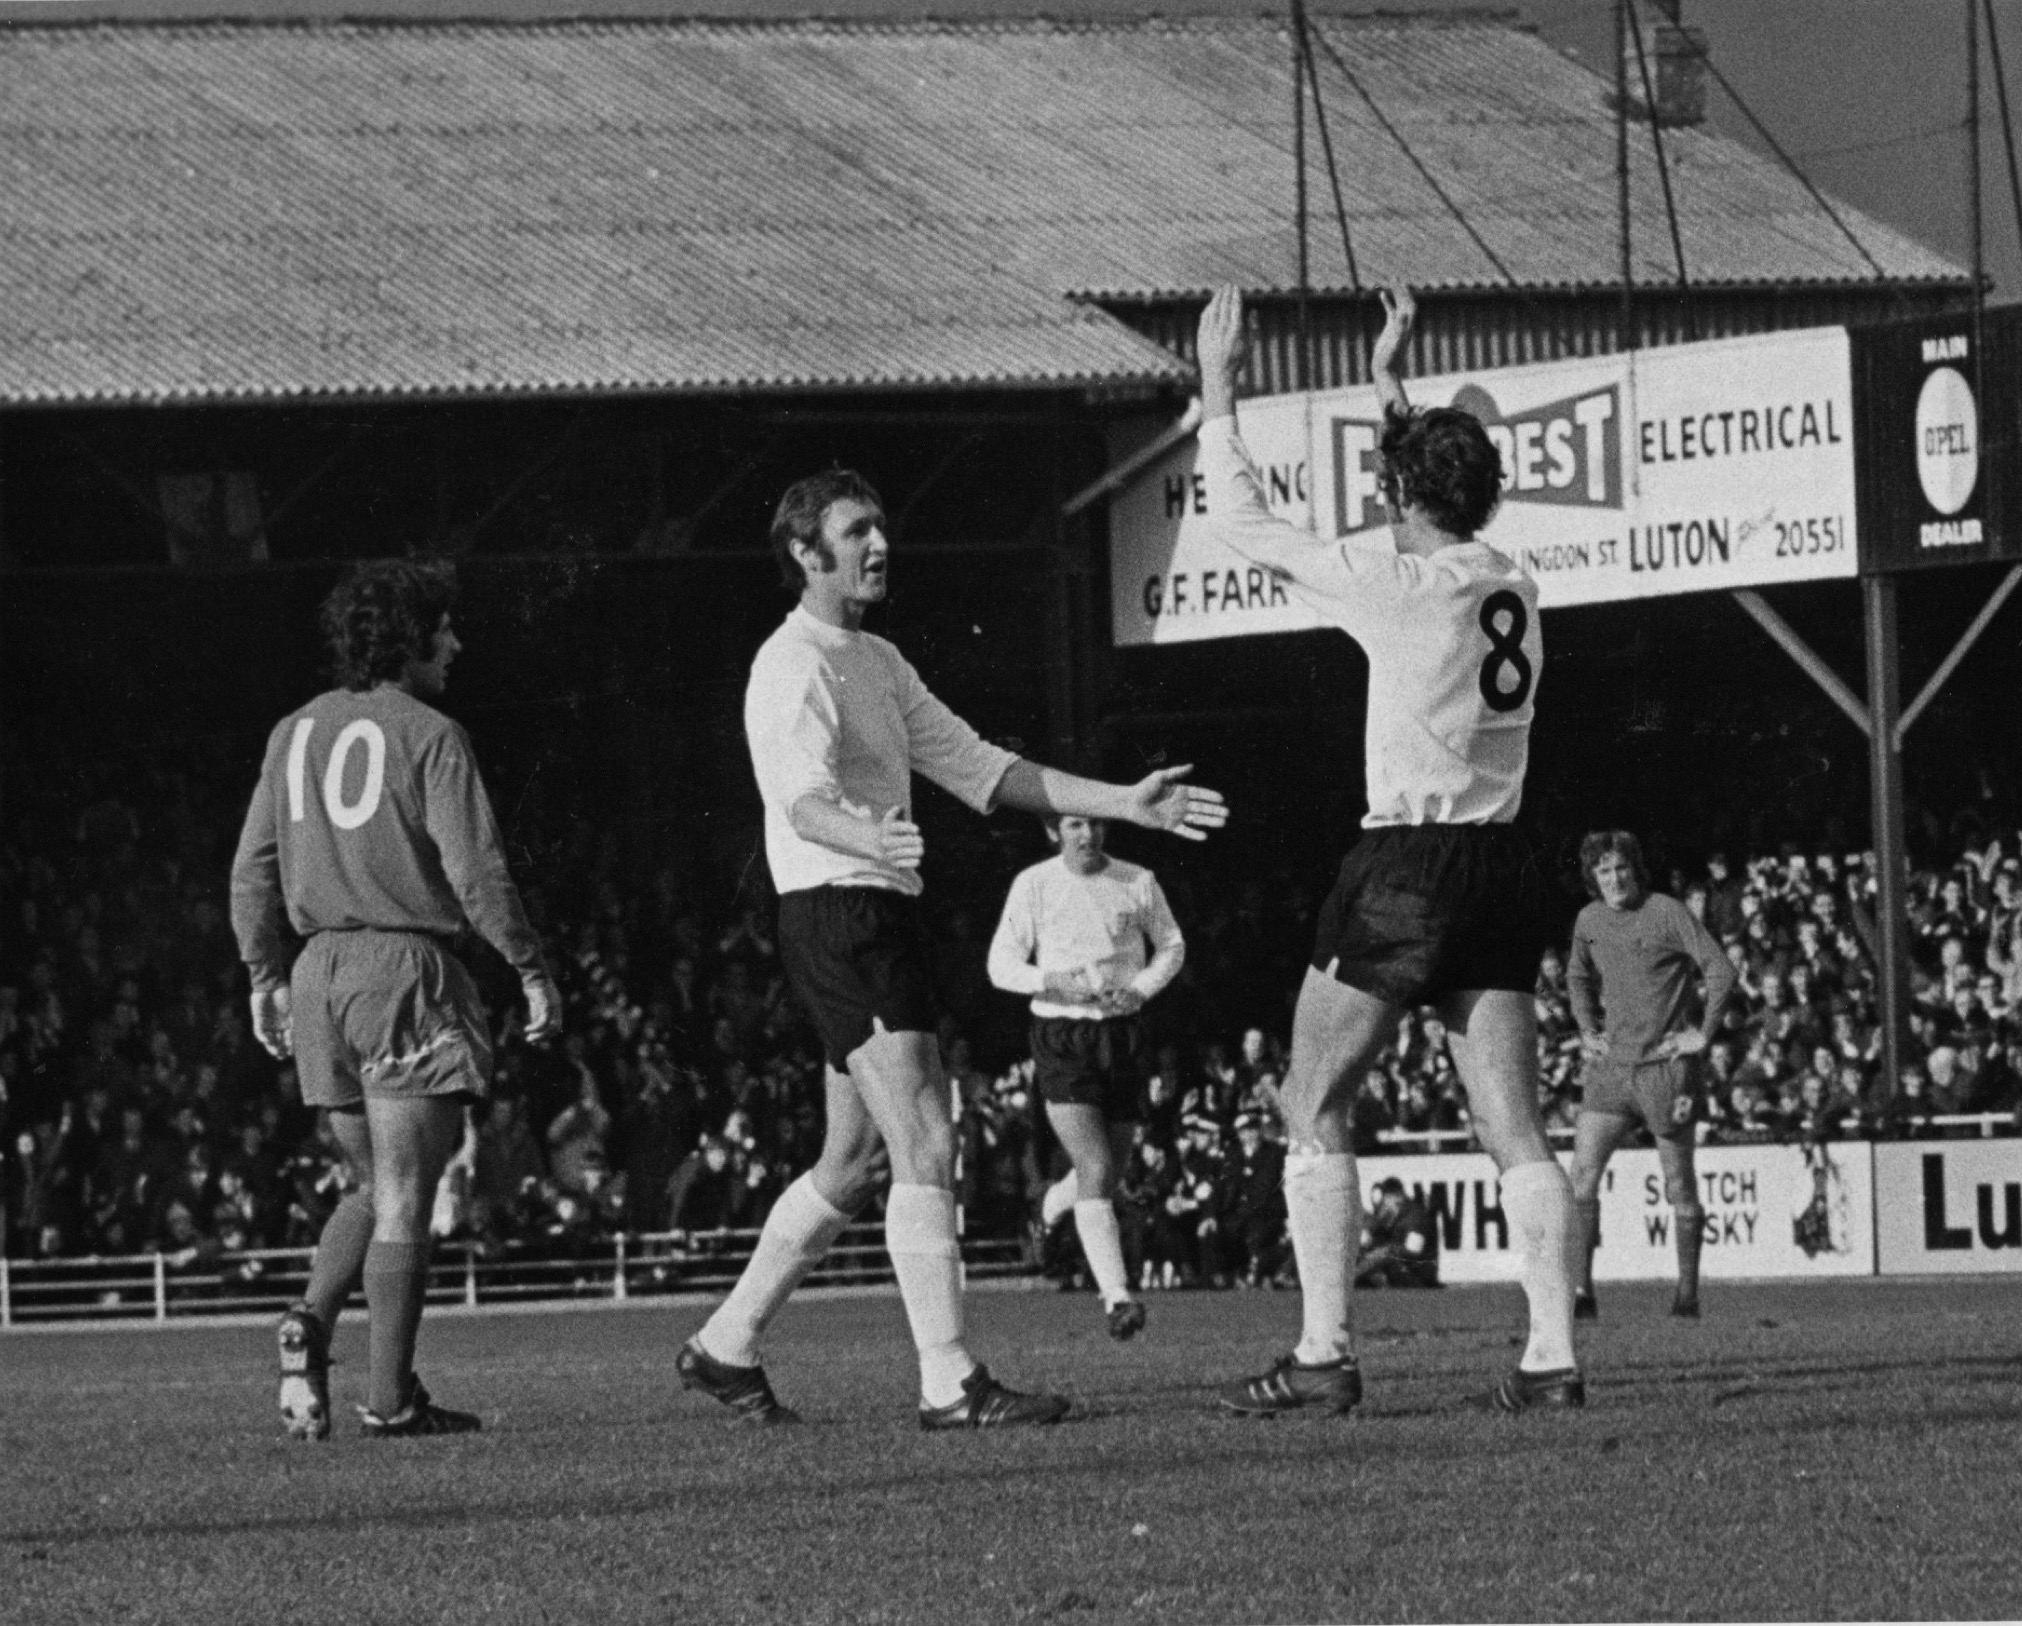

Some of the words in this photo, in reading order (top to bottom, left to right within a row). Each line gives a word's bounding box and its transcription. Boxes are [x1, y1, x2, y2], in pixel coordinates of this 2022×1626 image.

[1641, 398, 1842, 464] ELECTRICAL
[1925, 423, 1969, 456] OPEL
[1629, 517, 1730, 572] LUTON
[1775, 514, 1844, 557] 20551
[1479, 589, 1532, 713] 8
[287, 718, 386, 829] 10
[1645, 1169, 1757, 1206] STCH
[1644, 1210, 1760, 1246] WSKY
